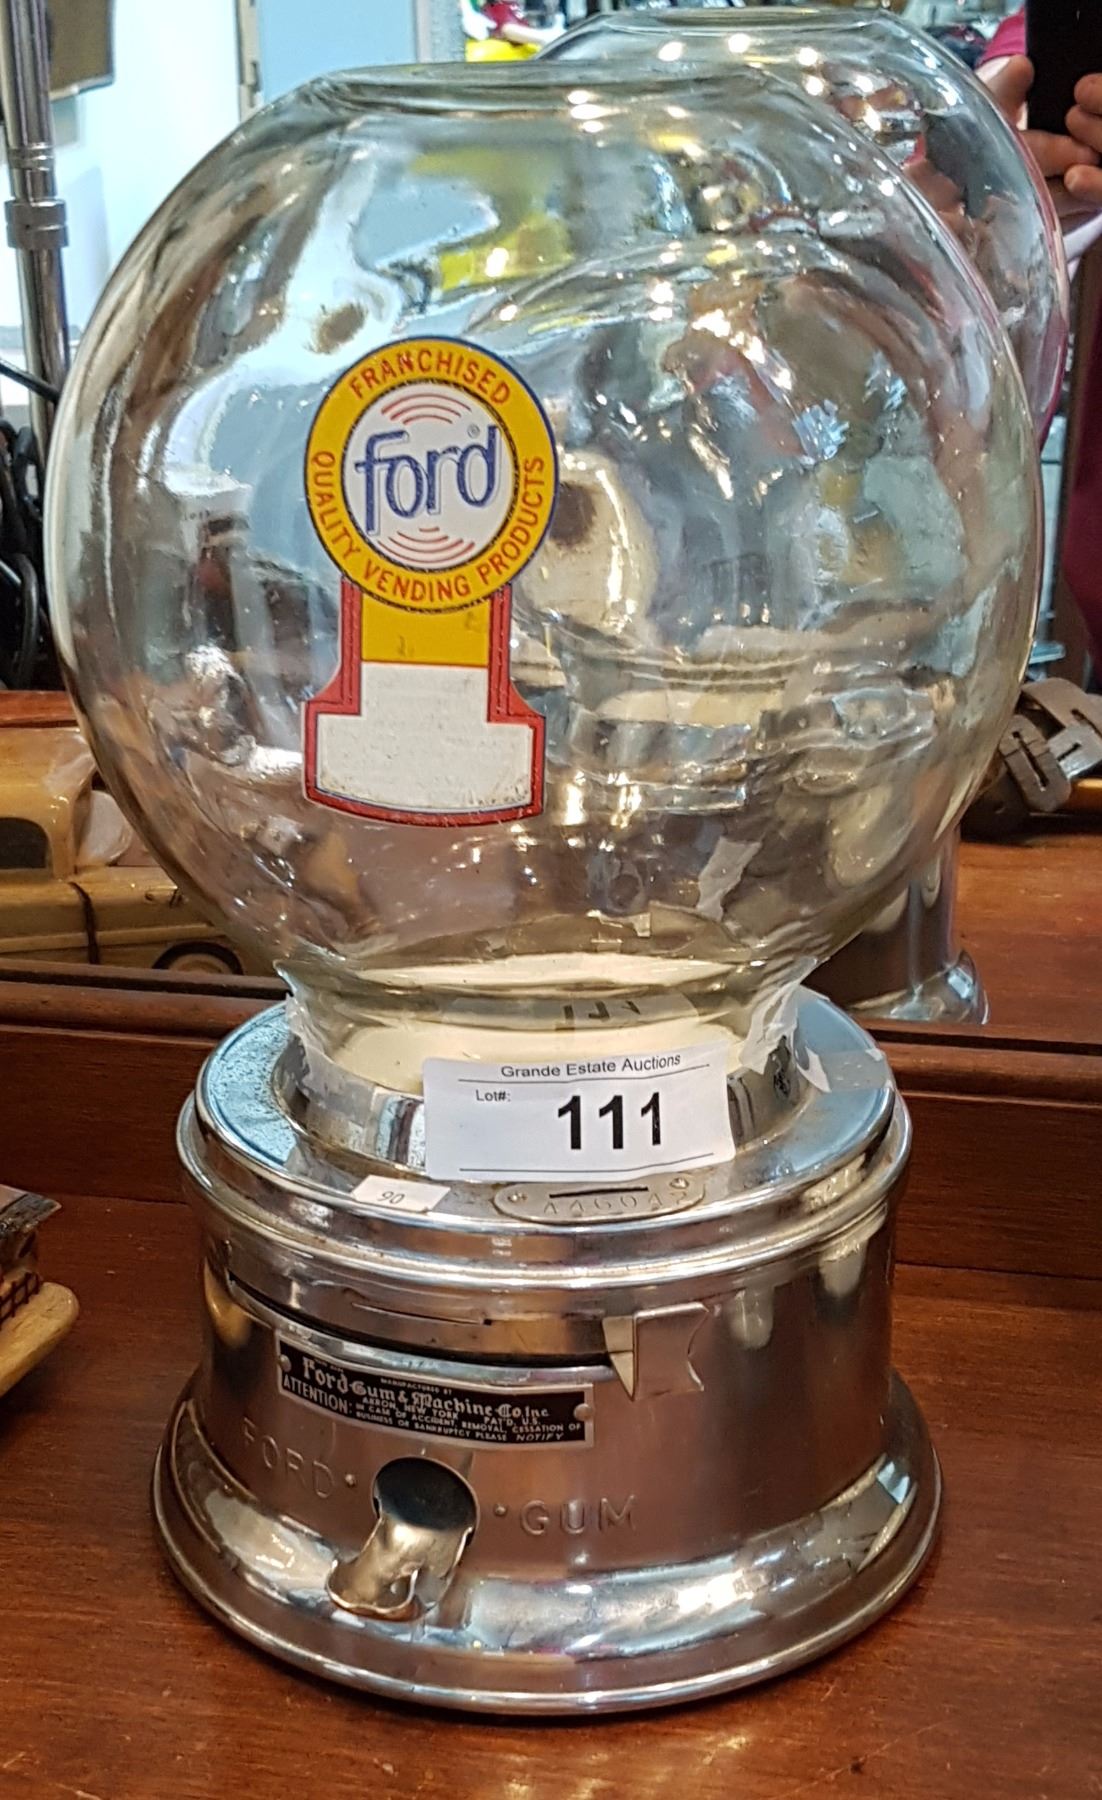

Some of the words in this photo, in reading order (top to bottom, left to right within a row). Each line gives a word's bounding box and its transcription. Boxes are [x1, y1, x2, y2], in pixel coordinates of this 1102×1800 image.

[350, 349, 511, 405] FRANCHISED
[311, 451, 361, 558] QUALITY
[363, 558, 471, 603] VENDING
[477, 456, 545, 585] PRODUCTS
[501, 1065, 561, 1078] Grande
[566, 1061, 617, 1076] Estate
[621, 1053, 681, 1072] Auctions
[475, 1089, 512, 1102] Lot#:
[557, 1091, 662, 1151] 111
[398, 1389, 408, 1404] &
[411, 1390, 493, 1417] Machine
[404, 1404, 427, 1415] NEW
[432, 1409, 459, 1420] YORK
[368, 1405, 391, 1416] CASE
[512, 1424, 564, 1434] CESSATION
[568, 1423, 581, 1431] OF
[475, 1431, 508, 1442] PLEASE
[516, 1432, 565, 1441] NOTIFY
[243, 1417, 336, 1498] FORD
[519, 1493, 637, 1537] GUM
